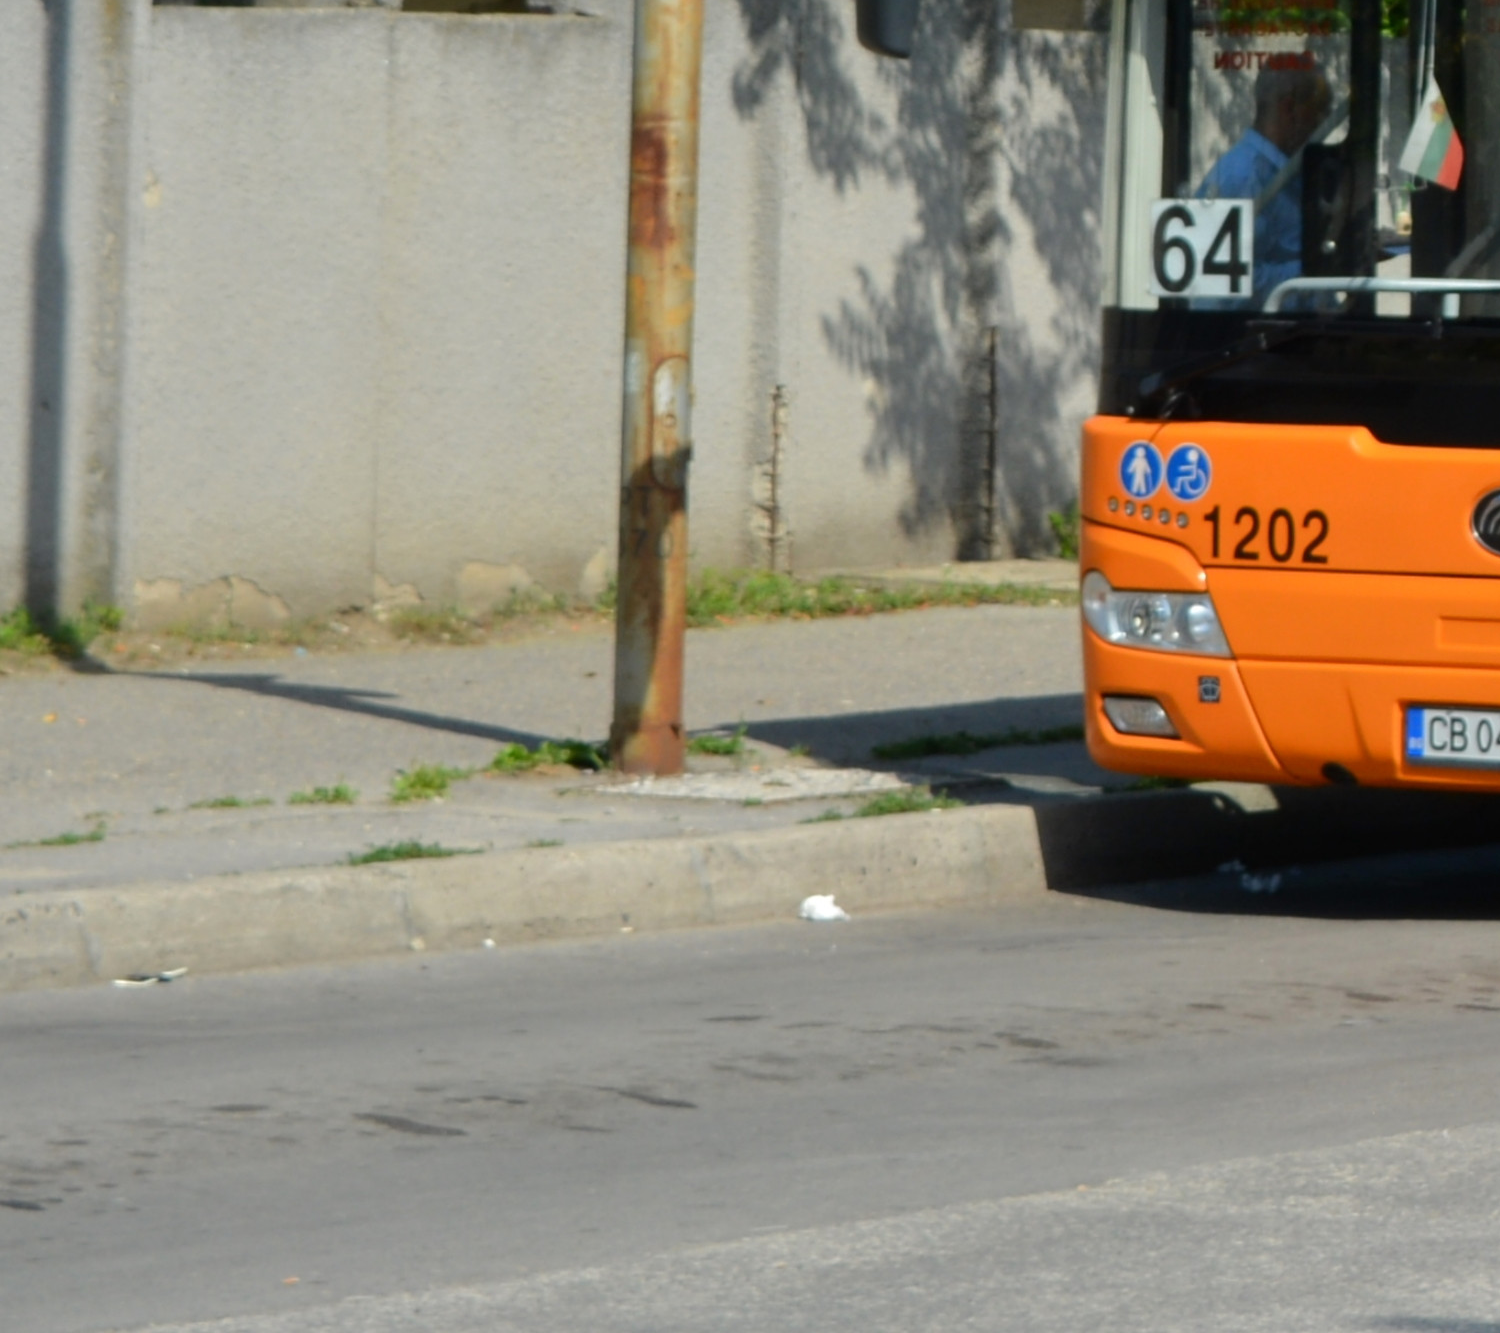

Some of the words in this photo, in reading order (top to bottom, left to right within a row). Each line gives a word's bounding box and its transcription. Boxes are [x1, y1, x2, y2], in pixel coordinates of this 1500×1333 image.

[1152, 204, 1249, 294] 64
[1203, 504, 1329, 565] 1202
[1428, 715, 1468, 753] CB
